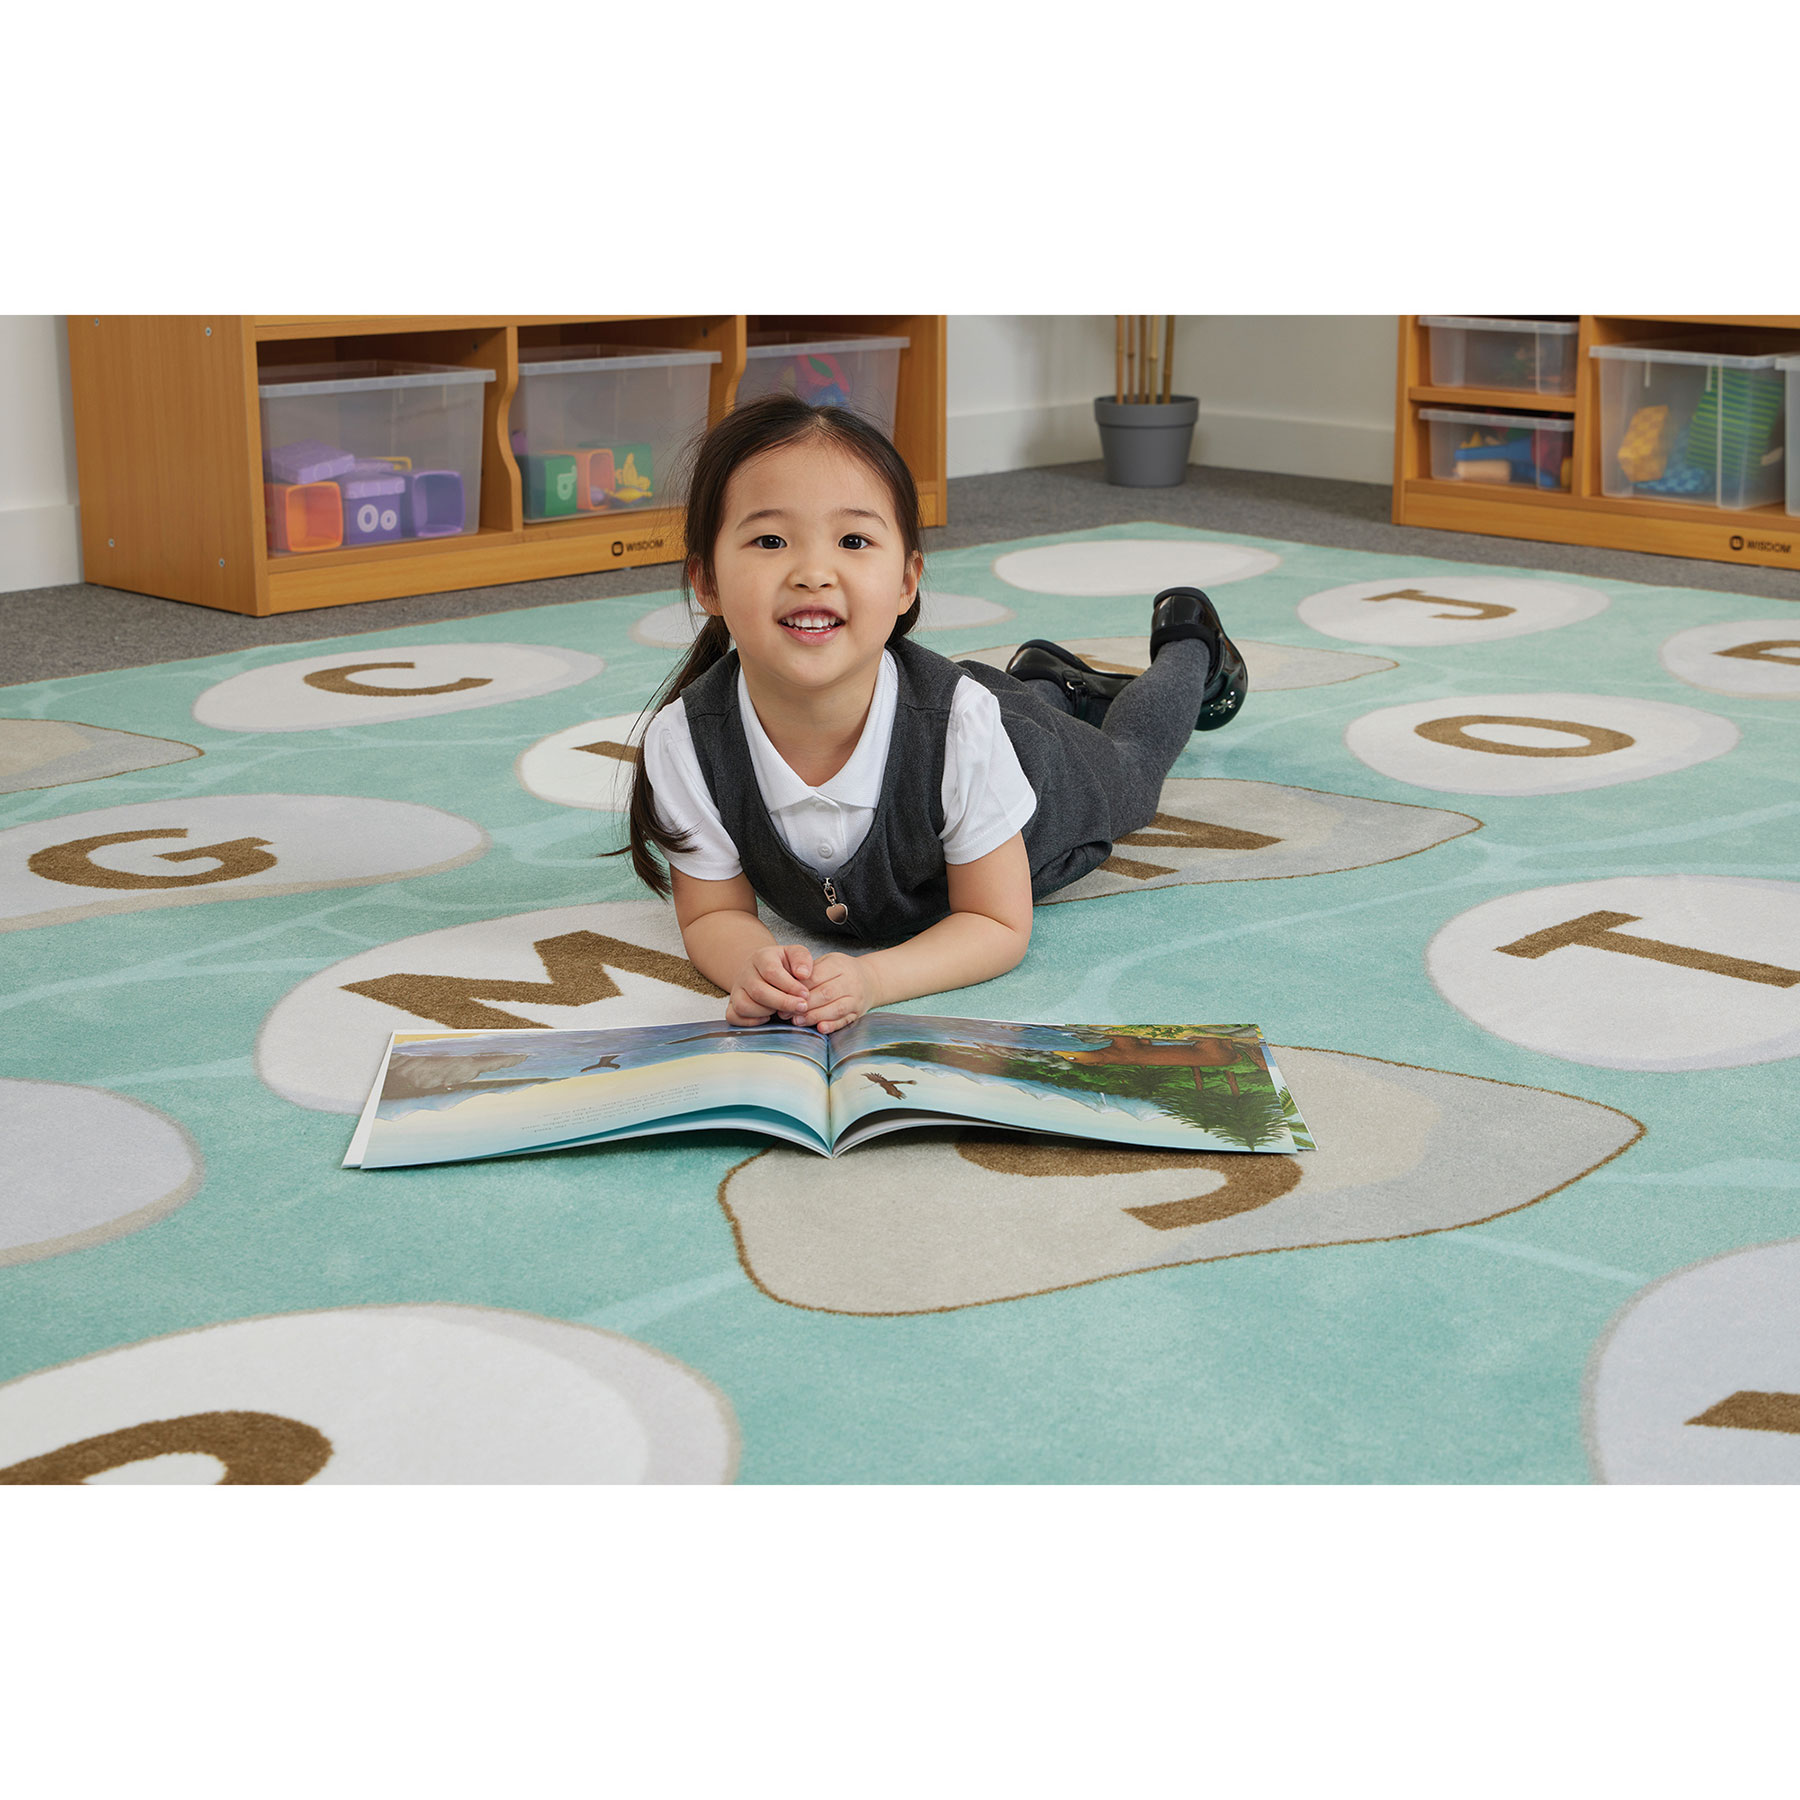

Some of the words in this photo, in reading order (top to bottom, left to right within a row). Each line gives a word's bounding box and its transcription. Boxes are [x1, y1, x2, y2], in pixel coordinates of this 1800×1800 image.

[626, 539, 664, 552] WISDOM
[1362, 588, 1518, 621] J
[303, 661, 493, 697] C
[1414, 714, 1635, 758] O
[27, 828, 278, 890] G
[1495, 910, 1800, 988] T
[338, 929, 731, 1029] M
